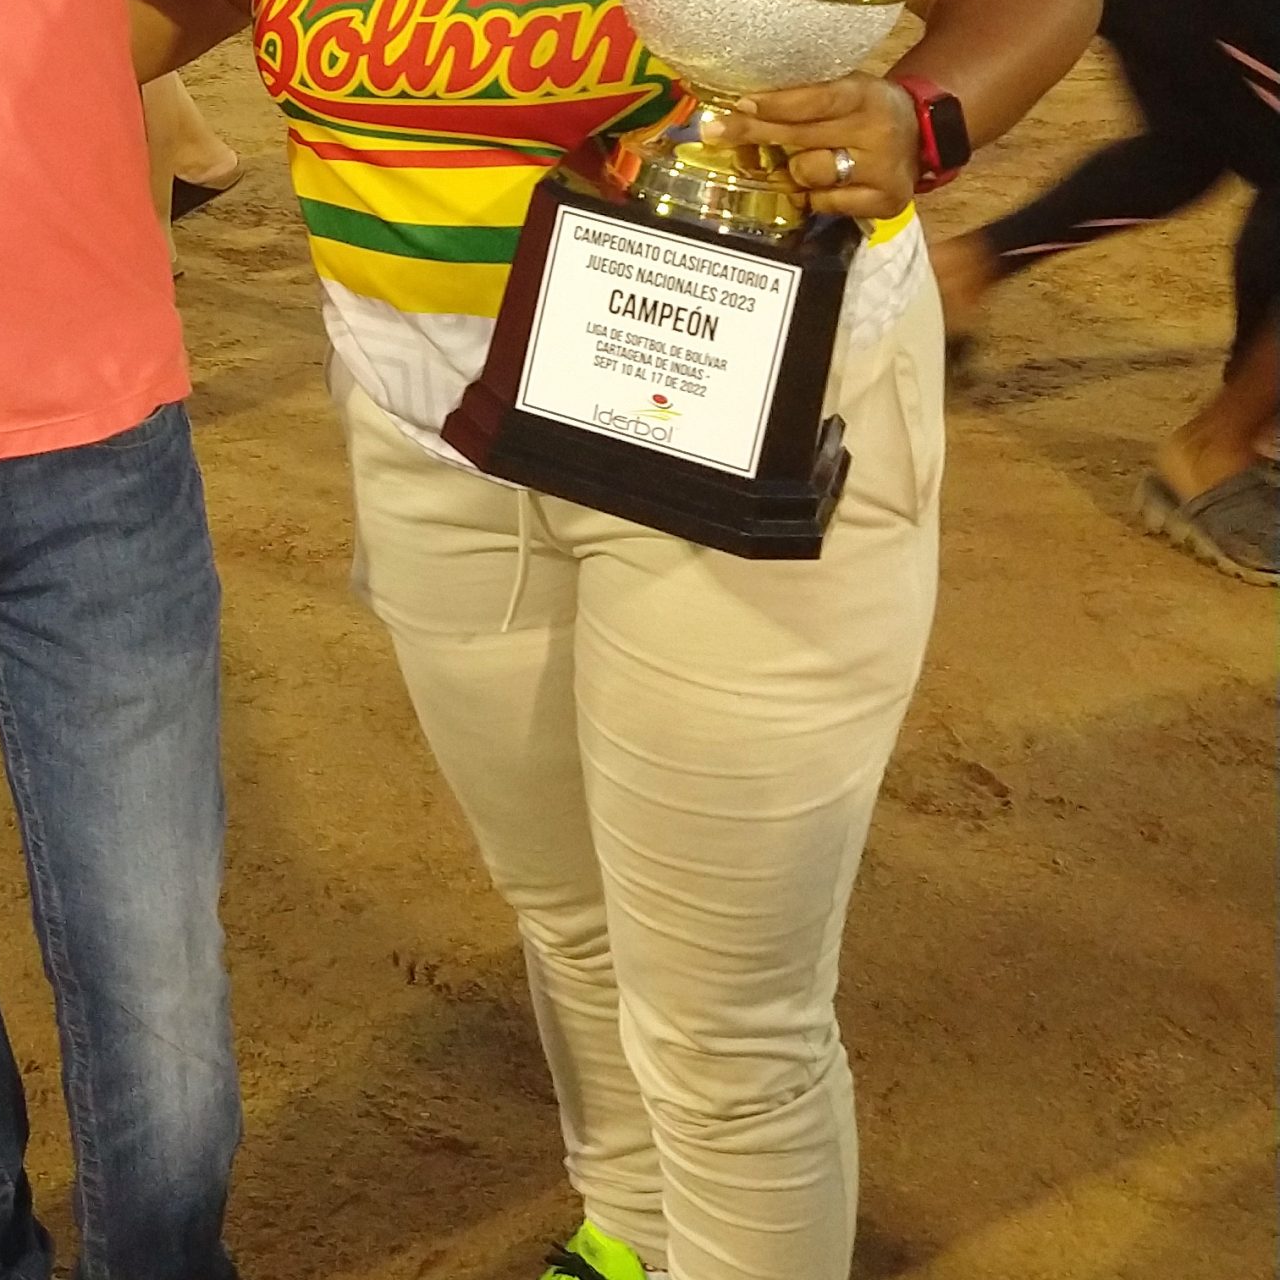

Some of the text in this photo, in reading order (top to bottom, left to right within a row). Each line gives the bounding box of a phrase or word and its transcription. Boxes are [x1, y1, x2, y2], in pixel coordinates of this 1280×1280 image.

[573, 225, 781, 294] CAMPEONATO CLASIFICATORIO A
[585, 254, 757, 313] JUEGOS NACIONALES 2023
[608, 288, 720, 342] CAMPEÓN
[586, 321, 608, 337] LIGA
[610, 327, 624, 342] DE
[625, 332, 668, 355] SOFTBOL
[670, 344, 684, 360] DE
[596, 339, 653, 367] CARTAGENA
[655, 356, 669, 371] DE
[670, 361, 705, 381] INDIAS
[593, 354, 708, 398] SEPT 10 AL 17 DE 2022
